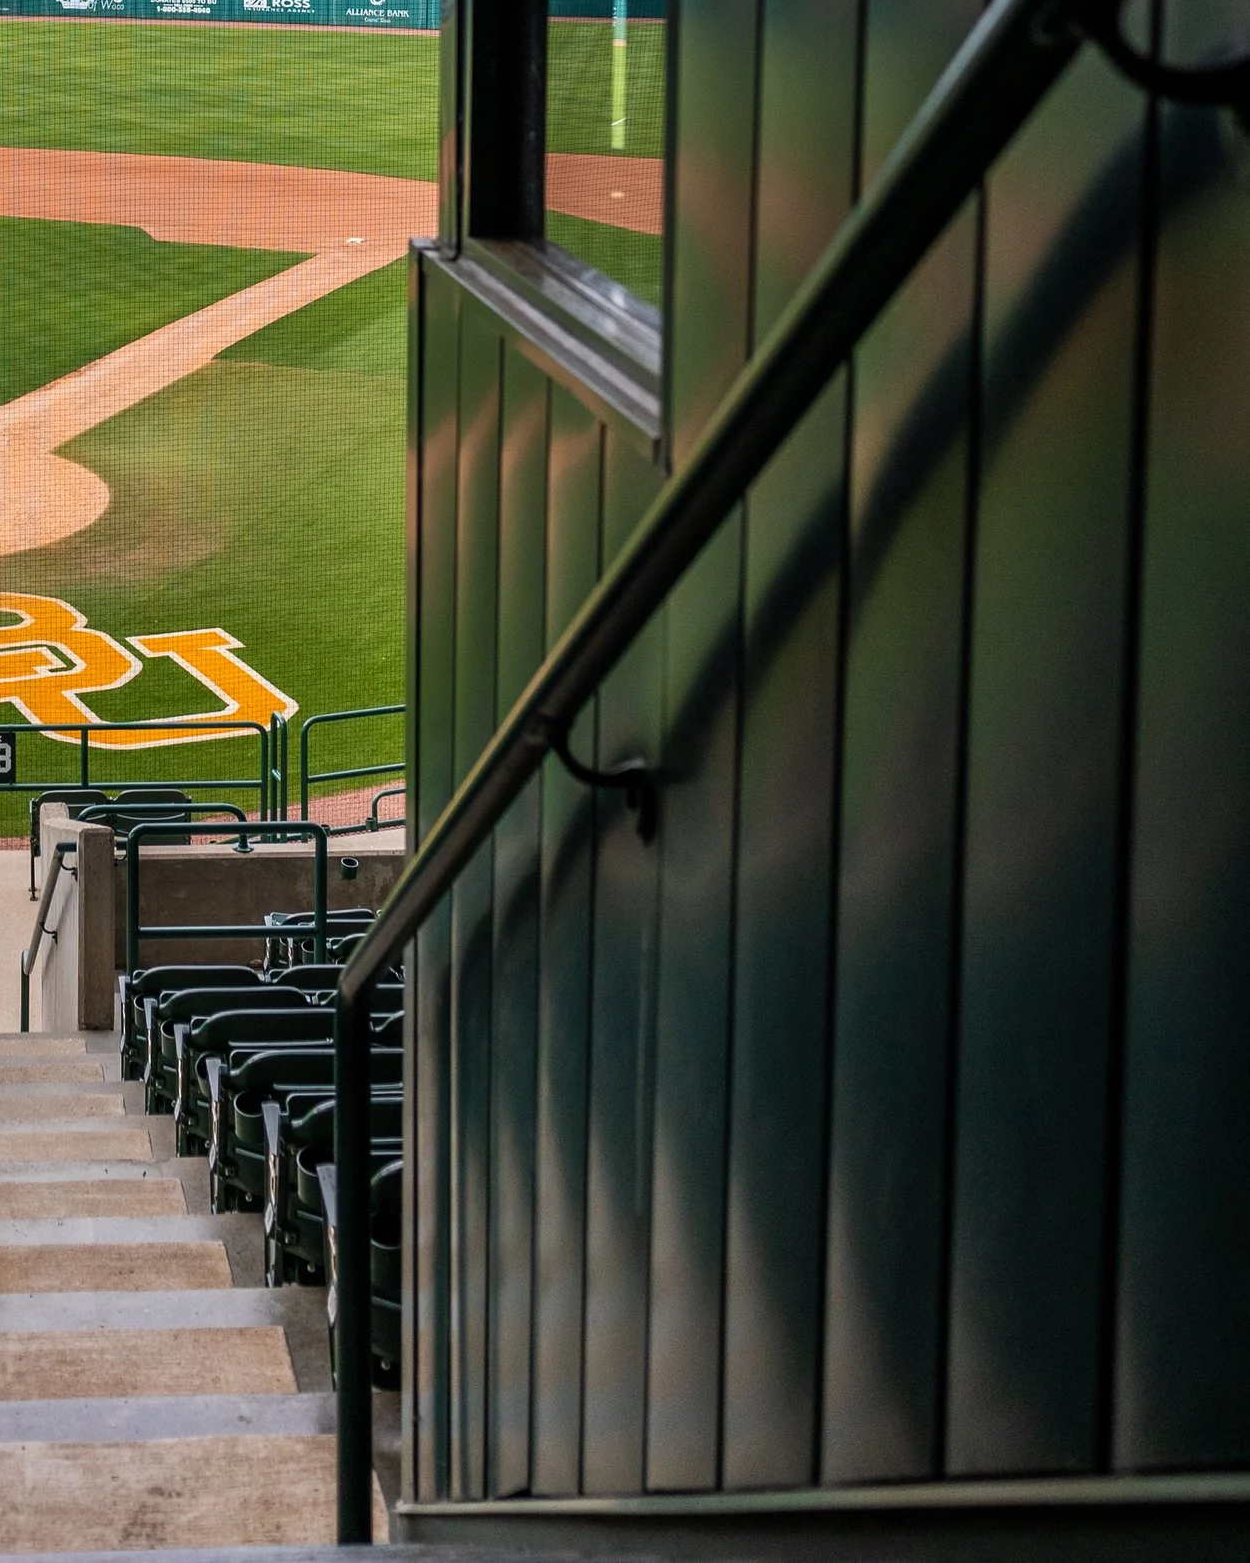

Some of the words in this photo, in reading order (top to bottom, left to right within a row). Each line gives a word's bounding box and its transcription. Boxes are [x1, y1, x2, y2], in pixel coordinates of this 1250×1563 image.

[88, 0, 99, 12] of
[101, 0, 125, 10] Waco
[345, 8, 385, 17] ALLIANCE
[387, 9, 410, 18] BANK
